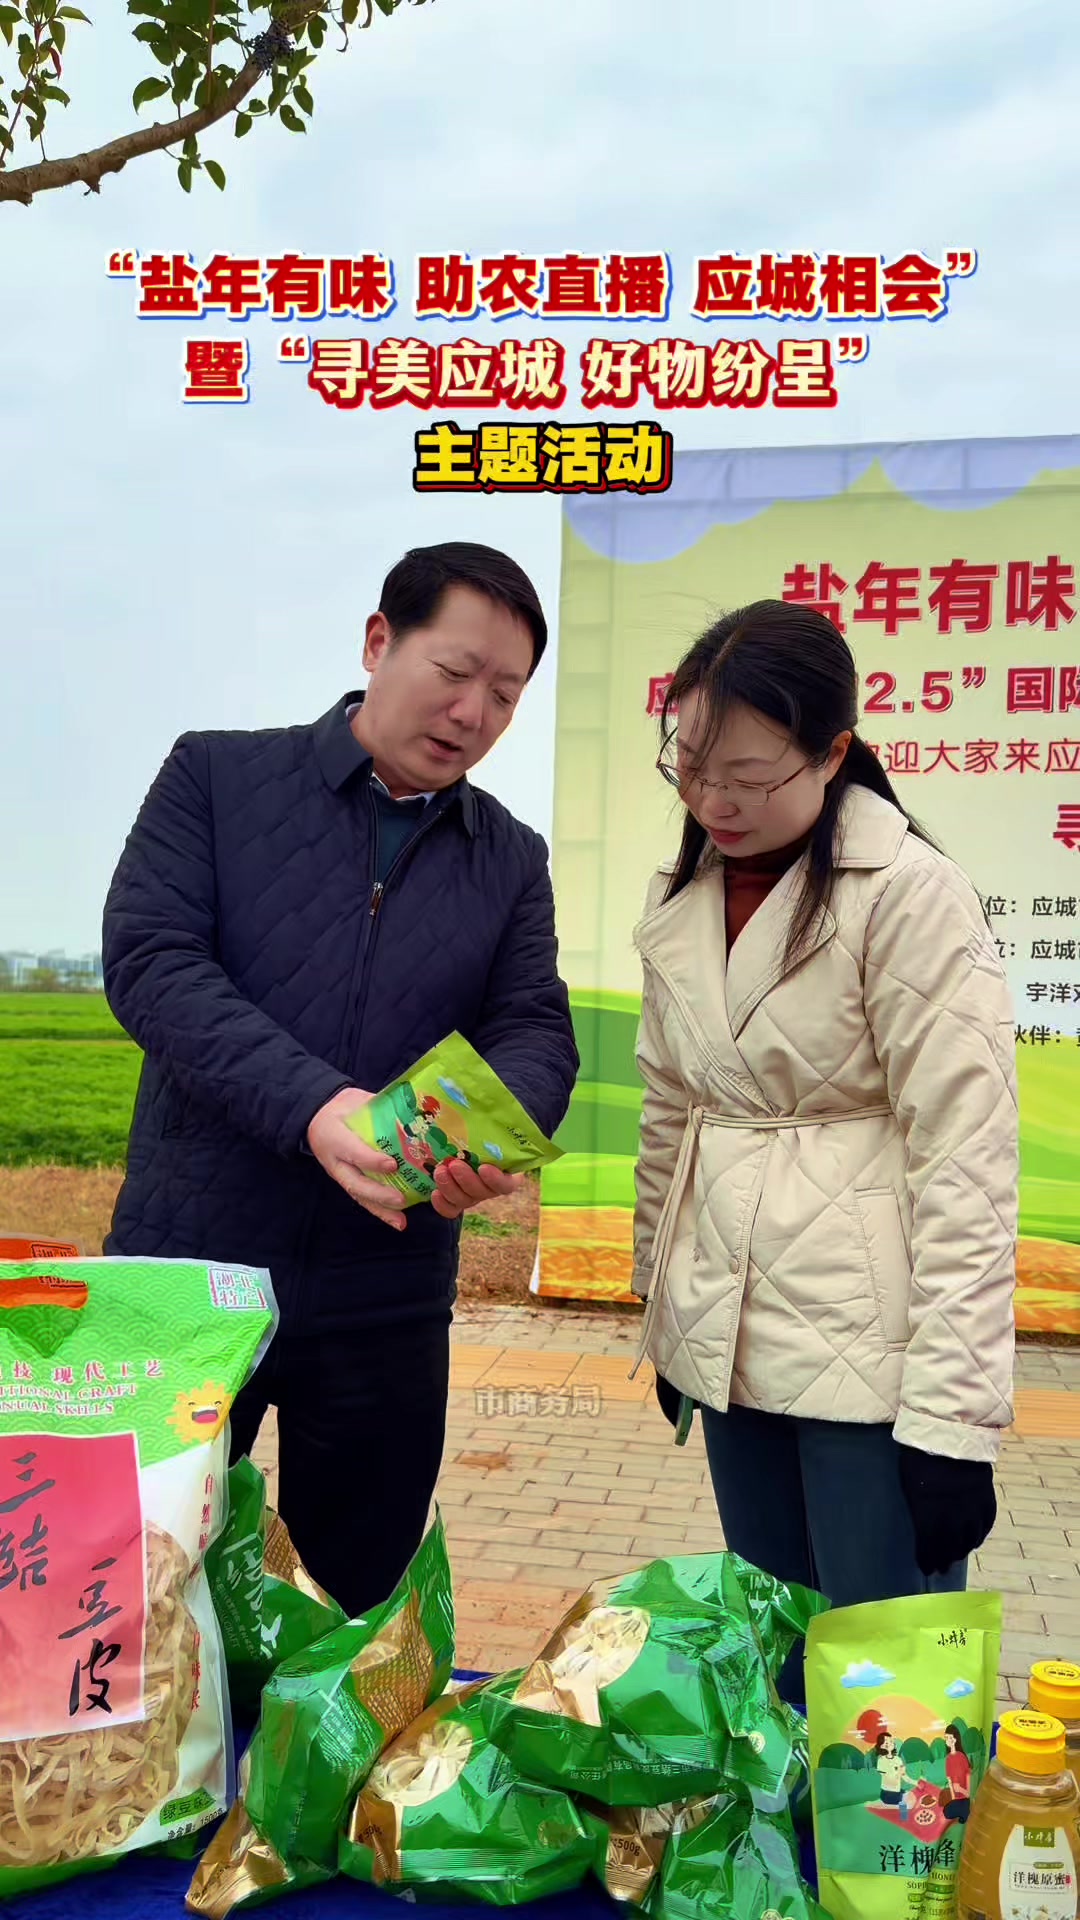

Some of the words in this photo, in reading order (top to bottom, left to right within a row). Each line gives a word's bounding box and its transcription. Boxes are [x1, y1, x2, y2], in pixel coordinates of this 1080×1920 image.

[781, 554, 1077, 635] 盐年有味
[868, 738, 1080, 775] 迎大家来应
[985, 895, 1080, 916] 位：应城
